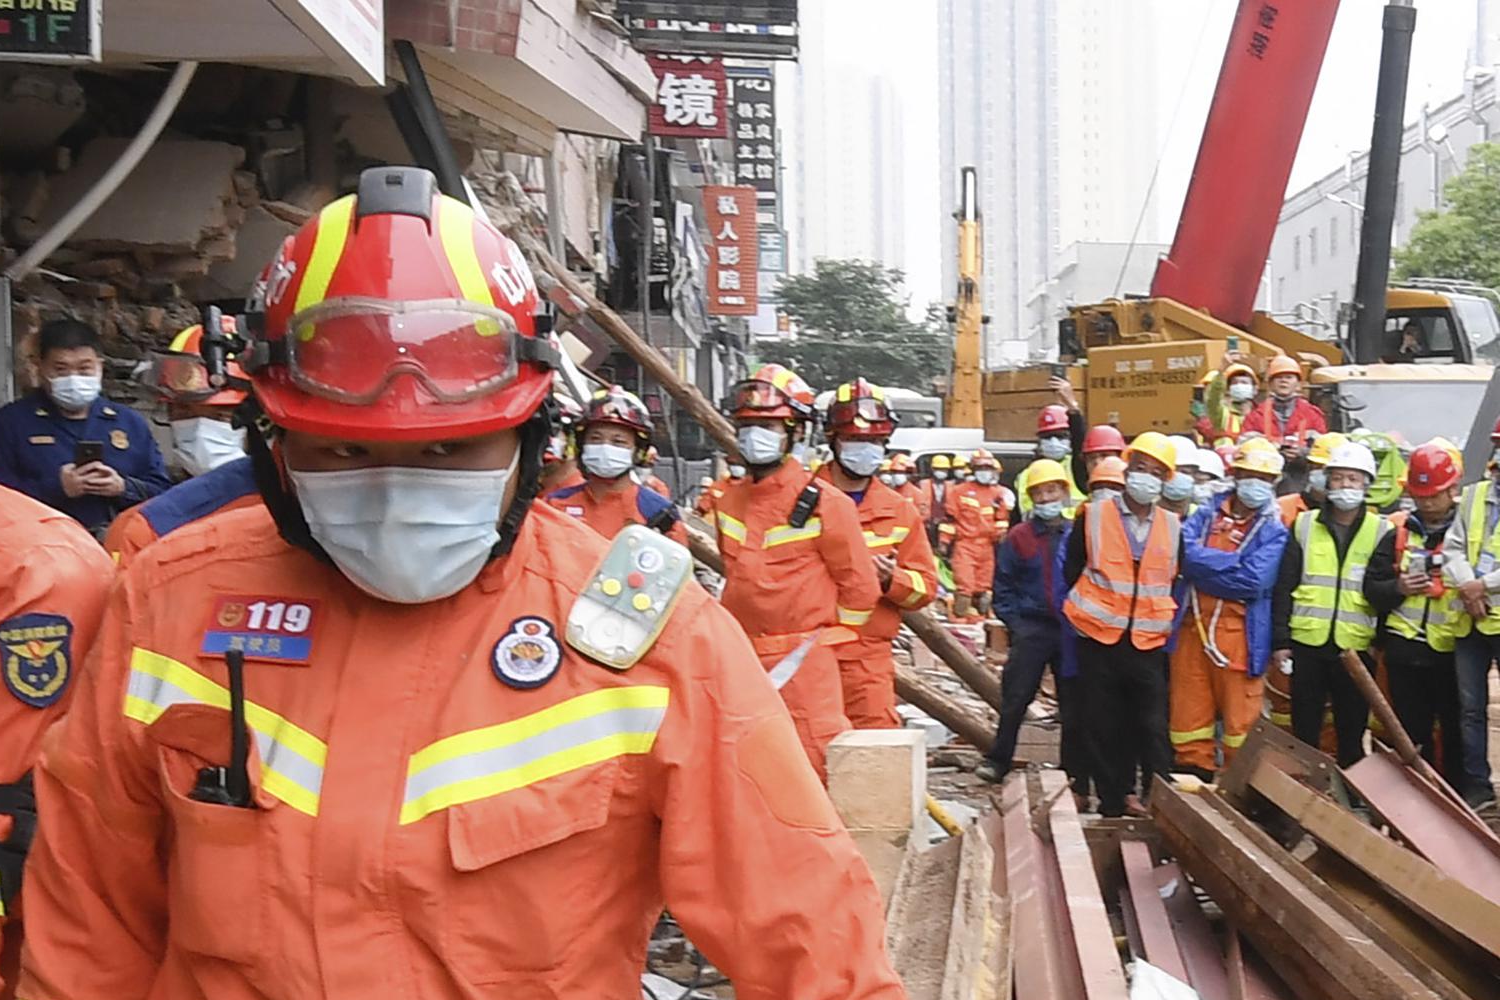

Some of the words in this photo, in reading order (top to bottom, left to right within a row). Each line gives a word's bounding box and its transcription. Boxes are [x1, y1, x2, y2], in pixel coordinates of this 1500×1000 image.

[657, 54, 718, 126] 镜
[716, 195, 740, 290] 私人影院
[247, 601, 312, 632] 119
